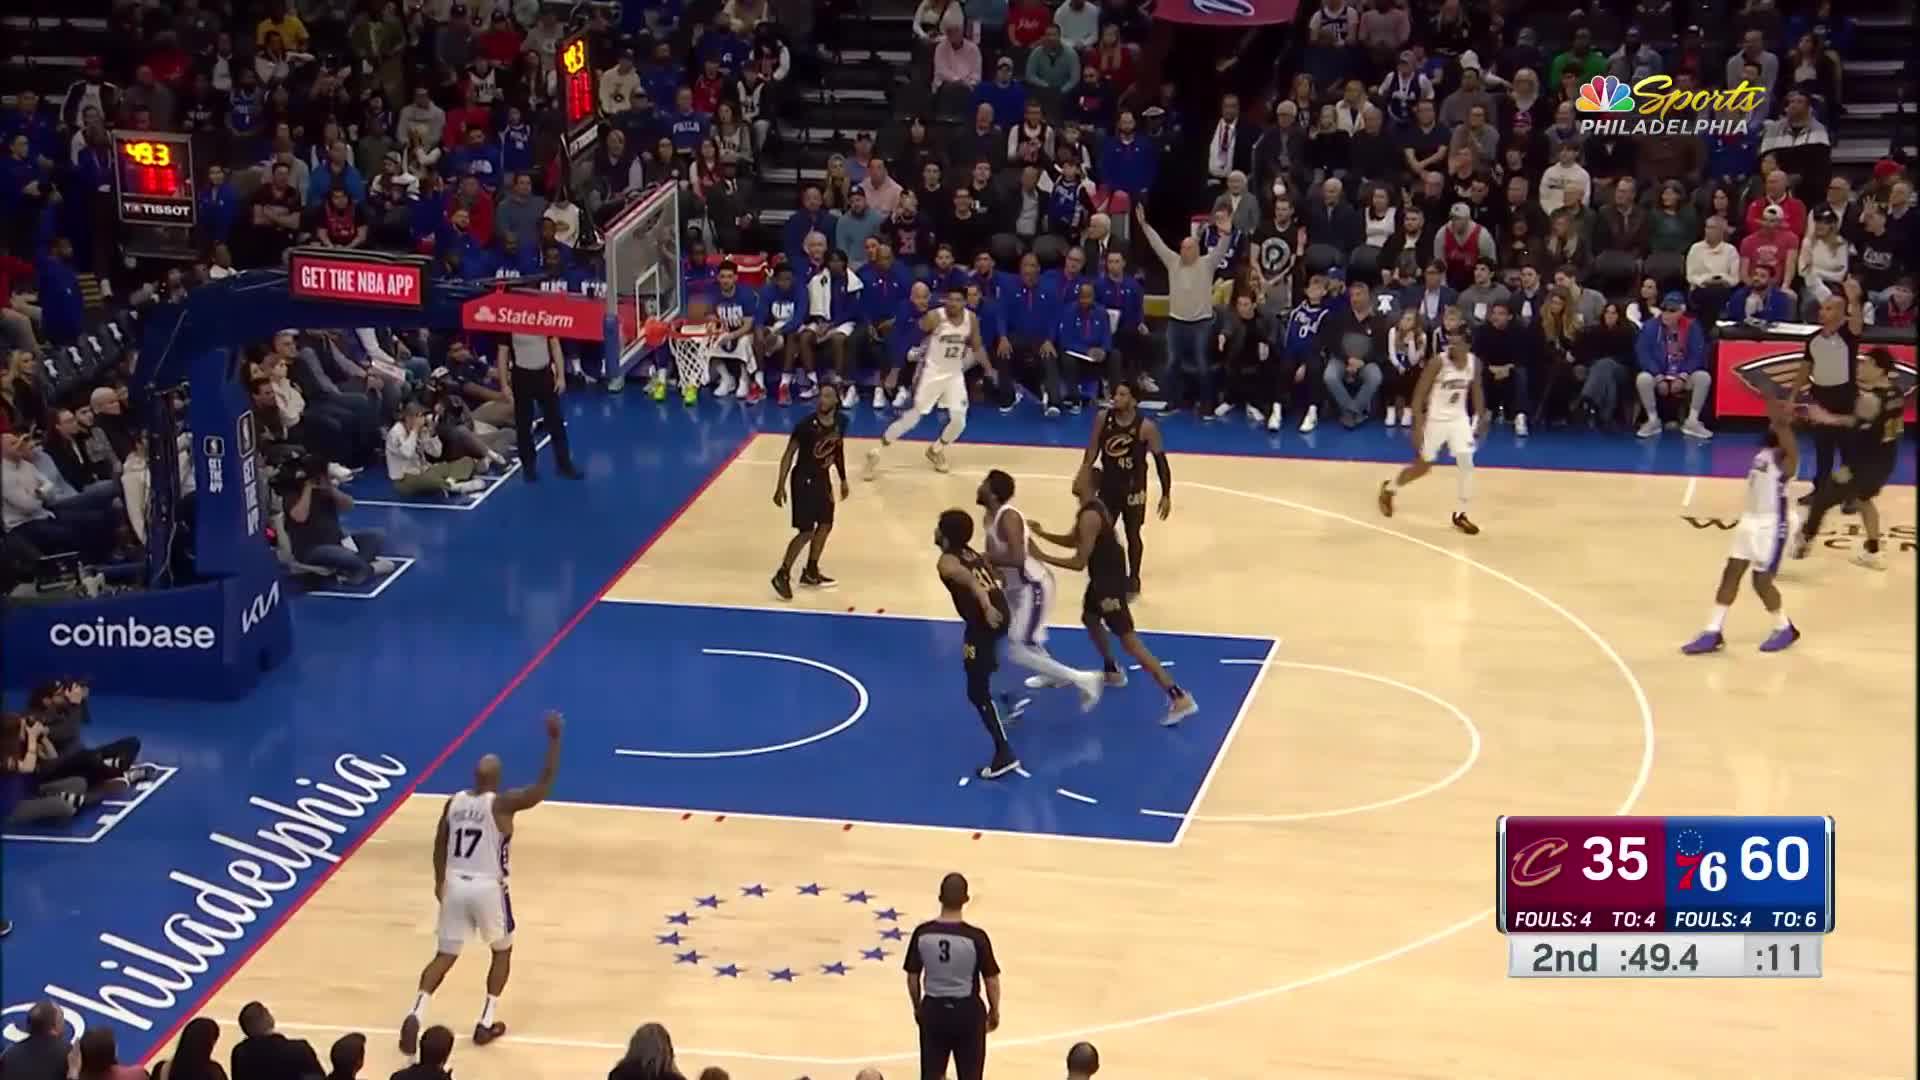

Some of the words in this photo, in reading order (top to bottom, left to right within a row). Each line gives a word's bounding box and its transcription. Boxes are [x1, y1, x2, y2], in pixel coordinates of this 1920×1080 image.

[143, 203, 190, 216] TISSOT
[301, 266, 327, 289] GET
[328, 268, 355, 292] THE
[357, 270, 385, 295] NBA
[387, 273, 414, 297] APP
[50, 616, 215, 649] coinbase
[454, 828, 482, 859] 17
[939, 940, 950, 963] 3
